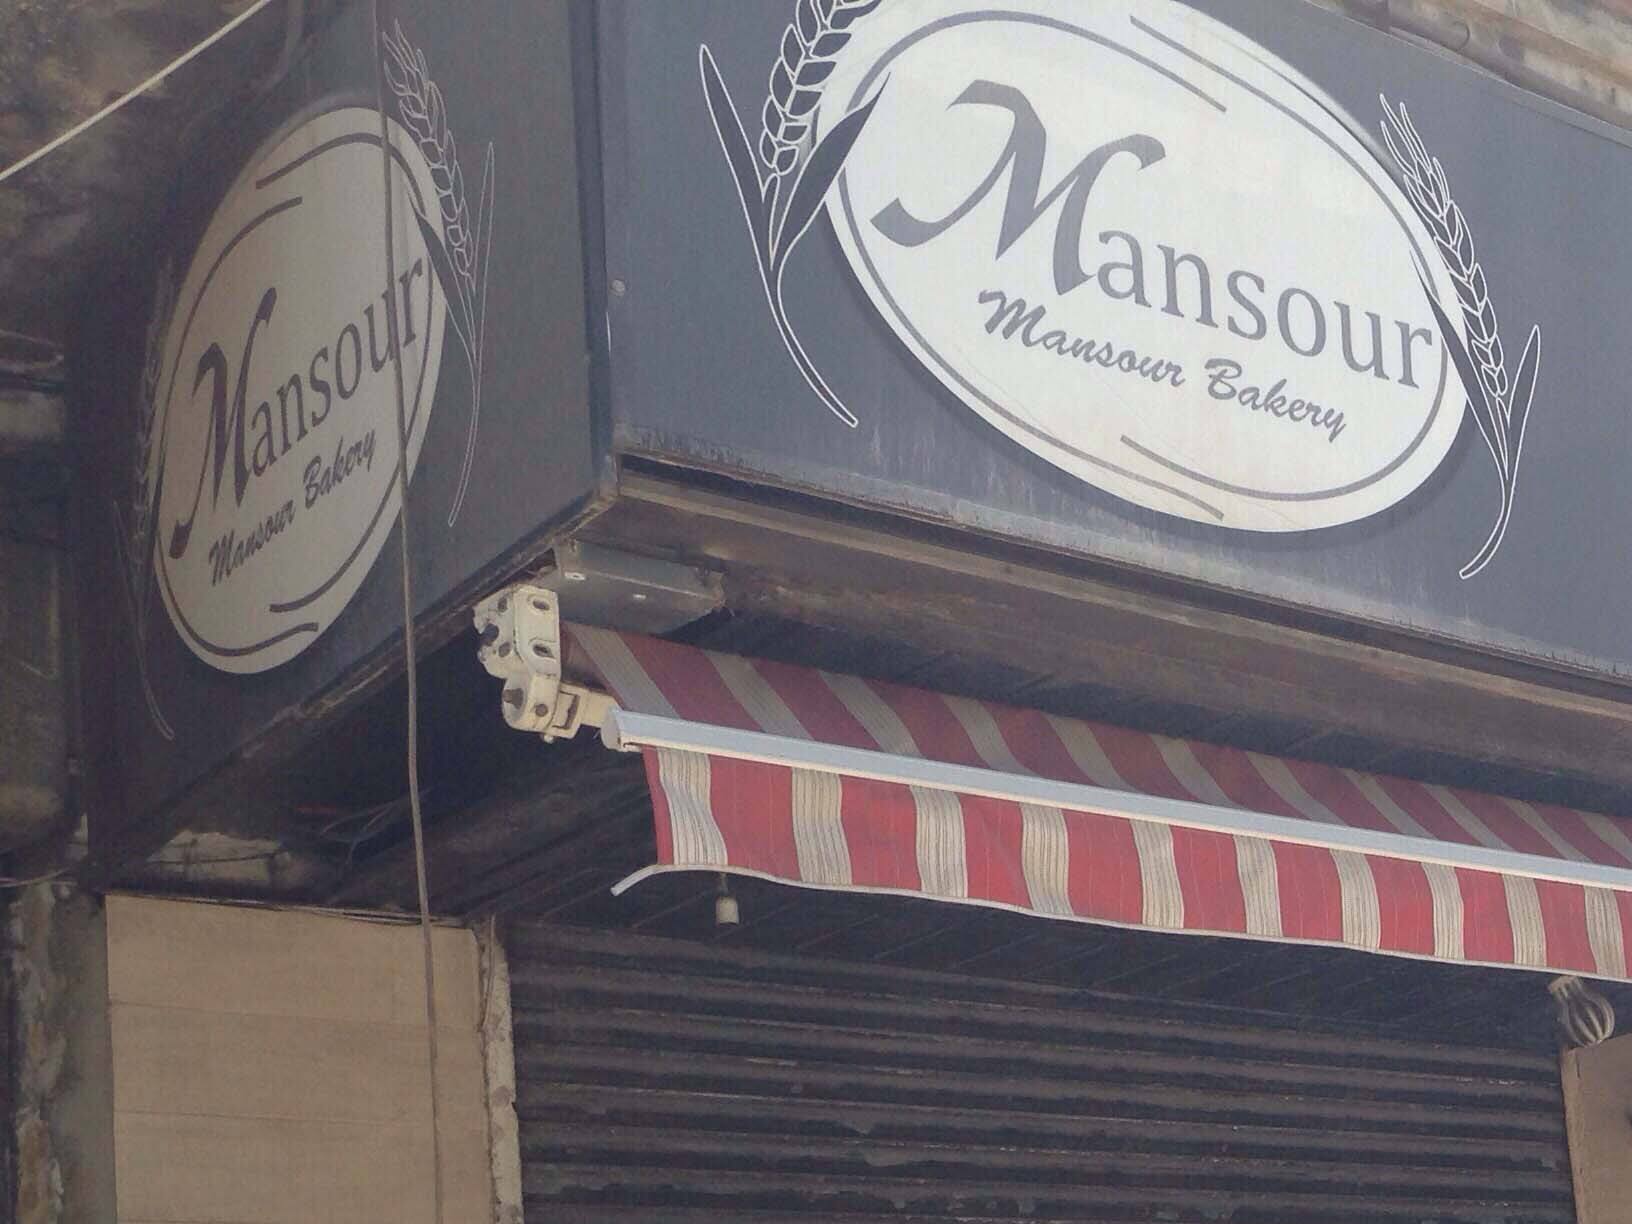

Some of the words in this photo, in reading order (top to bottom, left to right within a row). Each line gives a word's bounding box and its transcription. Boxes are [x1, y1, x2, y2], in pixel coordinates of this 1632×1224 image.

[870, 79, 1436, 391] Mansour
[169, 257, 423, 559] Mansour
[977, 289, 1186, 389] Mansour
[1204, 357, 1348, 442] Bakery
[207, 498, 297, 588] Mansour
[302, 429, 377, 510] Bakery
